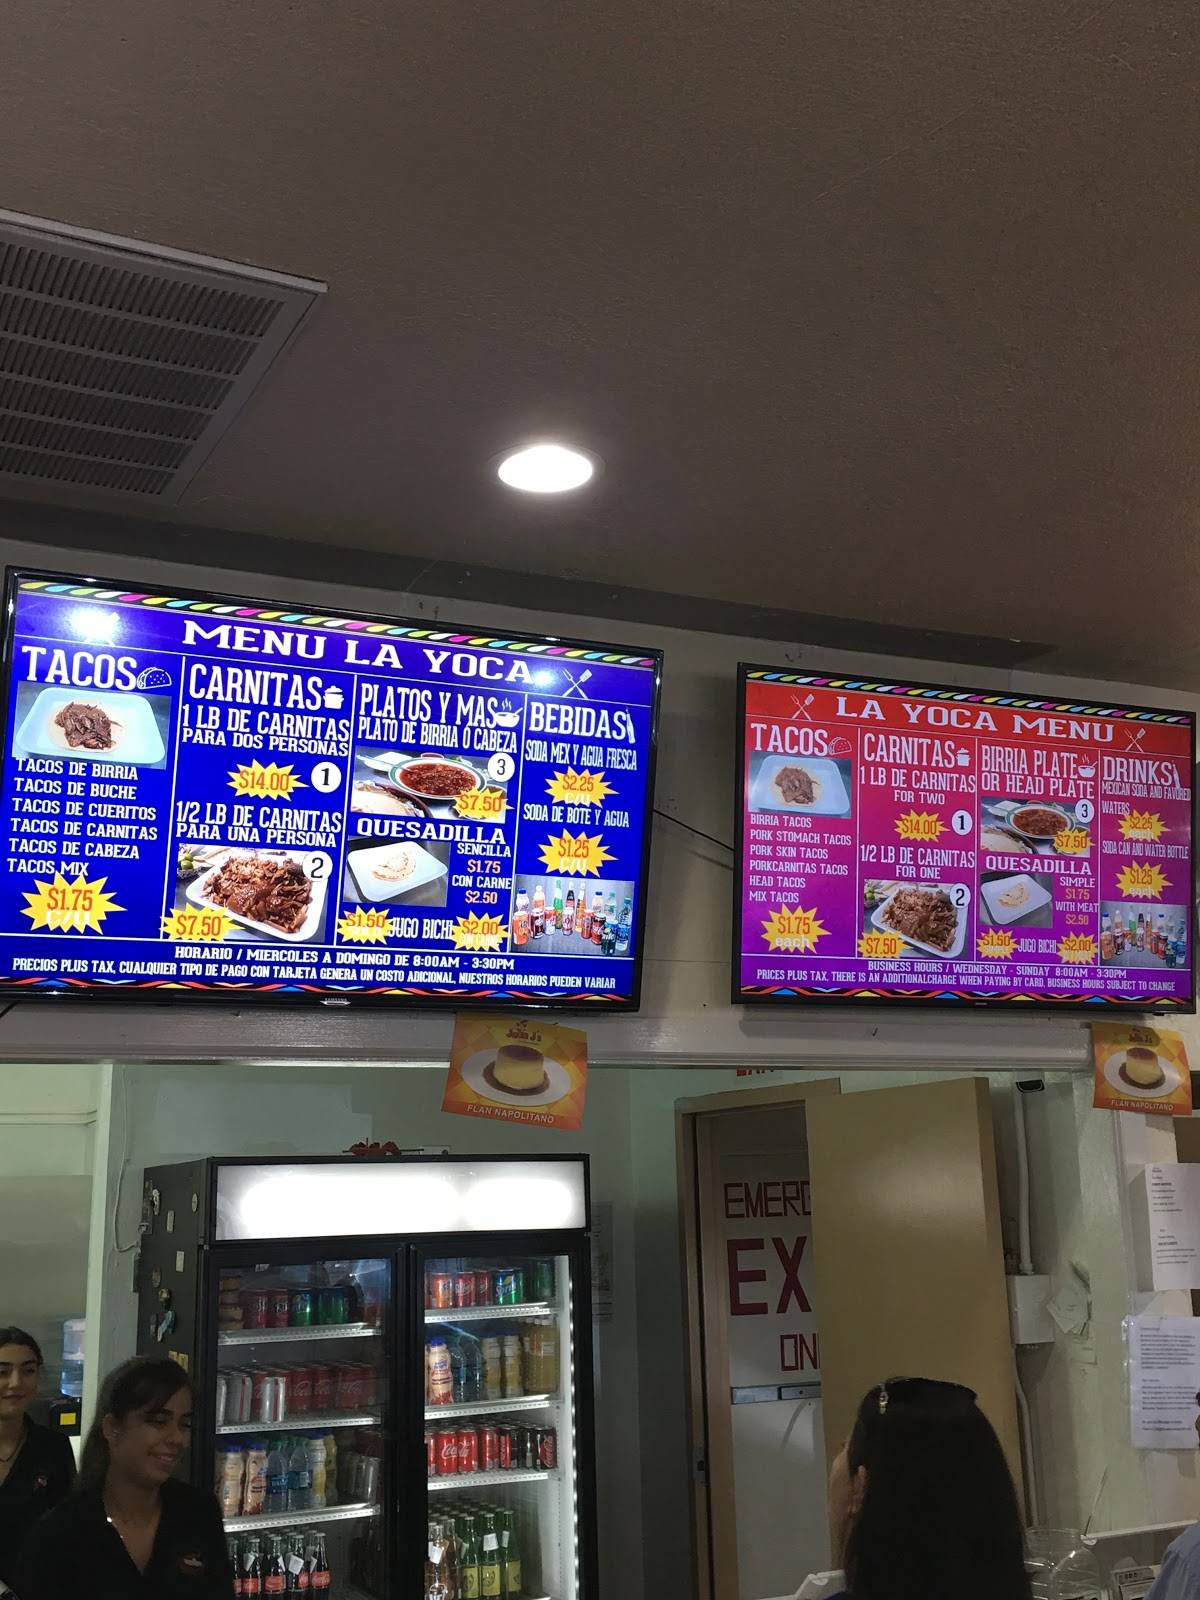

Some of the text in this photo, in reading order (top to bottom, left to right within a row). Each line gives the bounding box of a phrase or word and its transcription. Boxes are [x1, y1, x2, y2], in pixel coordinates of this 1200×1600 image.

[182, 620, 535, 684] MENU LA YOCA
[22, 646, 137, 690] TACOS
[189, 664, 321, 710] CARNITAS
[360, 684, 498, 728] PLATOS Y MAS
[182, 705, 350, 741] 1 LB DE CARNITAS
[529, 702, 626, 740] BEBIDAS
[836, 696, 1114, 742] LA YOCA MENU
[182, 728, 349, 756] PARA DOS PERSONAS
[358, 717, 398, 742] PLATO
[402, 721, 416, 742] DE
[420, 724, 458, 748] BIRRIA
[474, 728, 517, 753] CABEZA
[750, 723, 828, 756] TACOS
[526, 741, 637, 770] SODA MEX Y AGUA FRESCA
[864, 733, 954, 768] CARNITAS
[982, 744, 1078, 779] BIRRIA PLATE
[16, 757, 138, 780] TACOS DE BIRRIA
[870, 767, 975, 792] LB DE CARNITAS
[1103, 756, 1173, 786] DRINKS
[14, 778, 137, 800] TACOS DE BUCHE
[239, 769, 290, 791] $14.00
[562, 775, 594, 792] $2.25
[982, 773, 1094, 798] OR HEAD PLATE
[459, 793, 503, 812] $7.50
[894, 790, 944, 804] FOR TWO
[12, 798, 156, 821] TACOS DE CUERITOS
[176, 801, 342, 833] 1/2 LB DE CARNITAS
[524, 804, 629, 828] SODA DE BOTE Y AGUA
[11, 818, 158, 840] TACOS DE CARNITAS
[357, 817, 506, 844] QUESADILLA
[750, 814, 812, 828] BIRRIA TACOS
[176, 822, 336, 848] PARA UNA PERSONA
[750, 830, 852, 846] PORK STOMACH TACOS
[9, 838, 140, 859] TACOS DE CABEZA
[456, 842, 511, 858] SENCILLA
[558, 838, 589, 858] $1.25
[750, 845, 828, 859] PORK SKIN TACOS
[860, 845, 974, 868] 1/2 LB DE CARNITAS
[8, 858, 89, 876] TACOS MIX
[468, 860, 500, 874] $1.75
[820, 864, 848, 876] TACOS
[896, 865, 940, 878] FOR ONE
[985, 855, 1091, 874] QUESADILLA
[452, 874, 512, 890] CON CARNE
[750, 875, 806, 888] HEAD TACOS
[47, 889, 93, 911] $1.75
[465, 891, 497, 904] $2.50
[749, 891, 799, 902] MIX TACOS
[176, 916, 221, 936] $7.50
[778, 916, 810, 934] $1.75
[866, 938, 896, 954] $7.50
[175, 946, 514, 969] HORARIO MIERCOLES A DOMINGO DE 8:00AM 3:30PM
[13, 958, 58, 972] PRECIOS
[61, 960, 88, 972] PLUS
[120, 962, 176, 974] CUALQUIER
[180, 963, 202, 975] TIPO
[206, 964, 218, 976] DE
[222, 964, 247, 977] PAGO
[251, 966, 270, 978] CON
[273, 966, 316, 979] TARJETA
[320, 968, 356, 981] GENERA
[360, 969, 373, 980] UN
[376, 970, 404, 982] COSTO
[459, 972, 503, 985] NUESTROS
[506, 974, 547, 986] HORARIOS
[550, 976, 582, 987] PUEDEN
[584, 977, 616, 988] VARIAR
[757, 969, 784, 980] PRICES
[787, 970, 808, 980] PLUS
[831, 972, 856, 982] THERE
[858, 973, 866, 982] IS
[868, 973, 880, 982] AN
[868, 961, 1126, 978] BUSINESS HOURS WEDNESDAY SUNDAY 8:00AM 3:30PM
[467, 1104, 554, 1124] FLAN NAPOLITANO
[1130, 1101, 1174, 1110] NAPOLITANO
